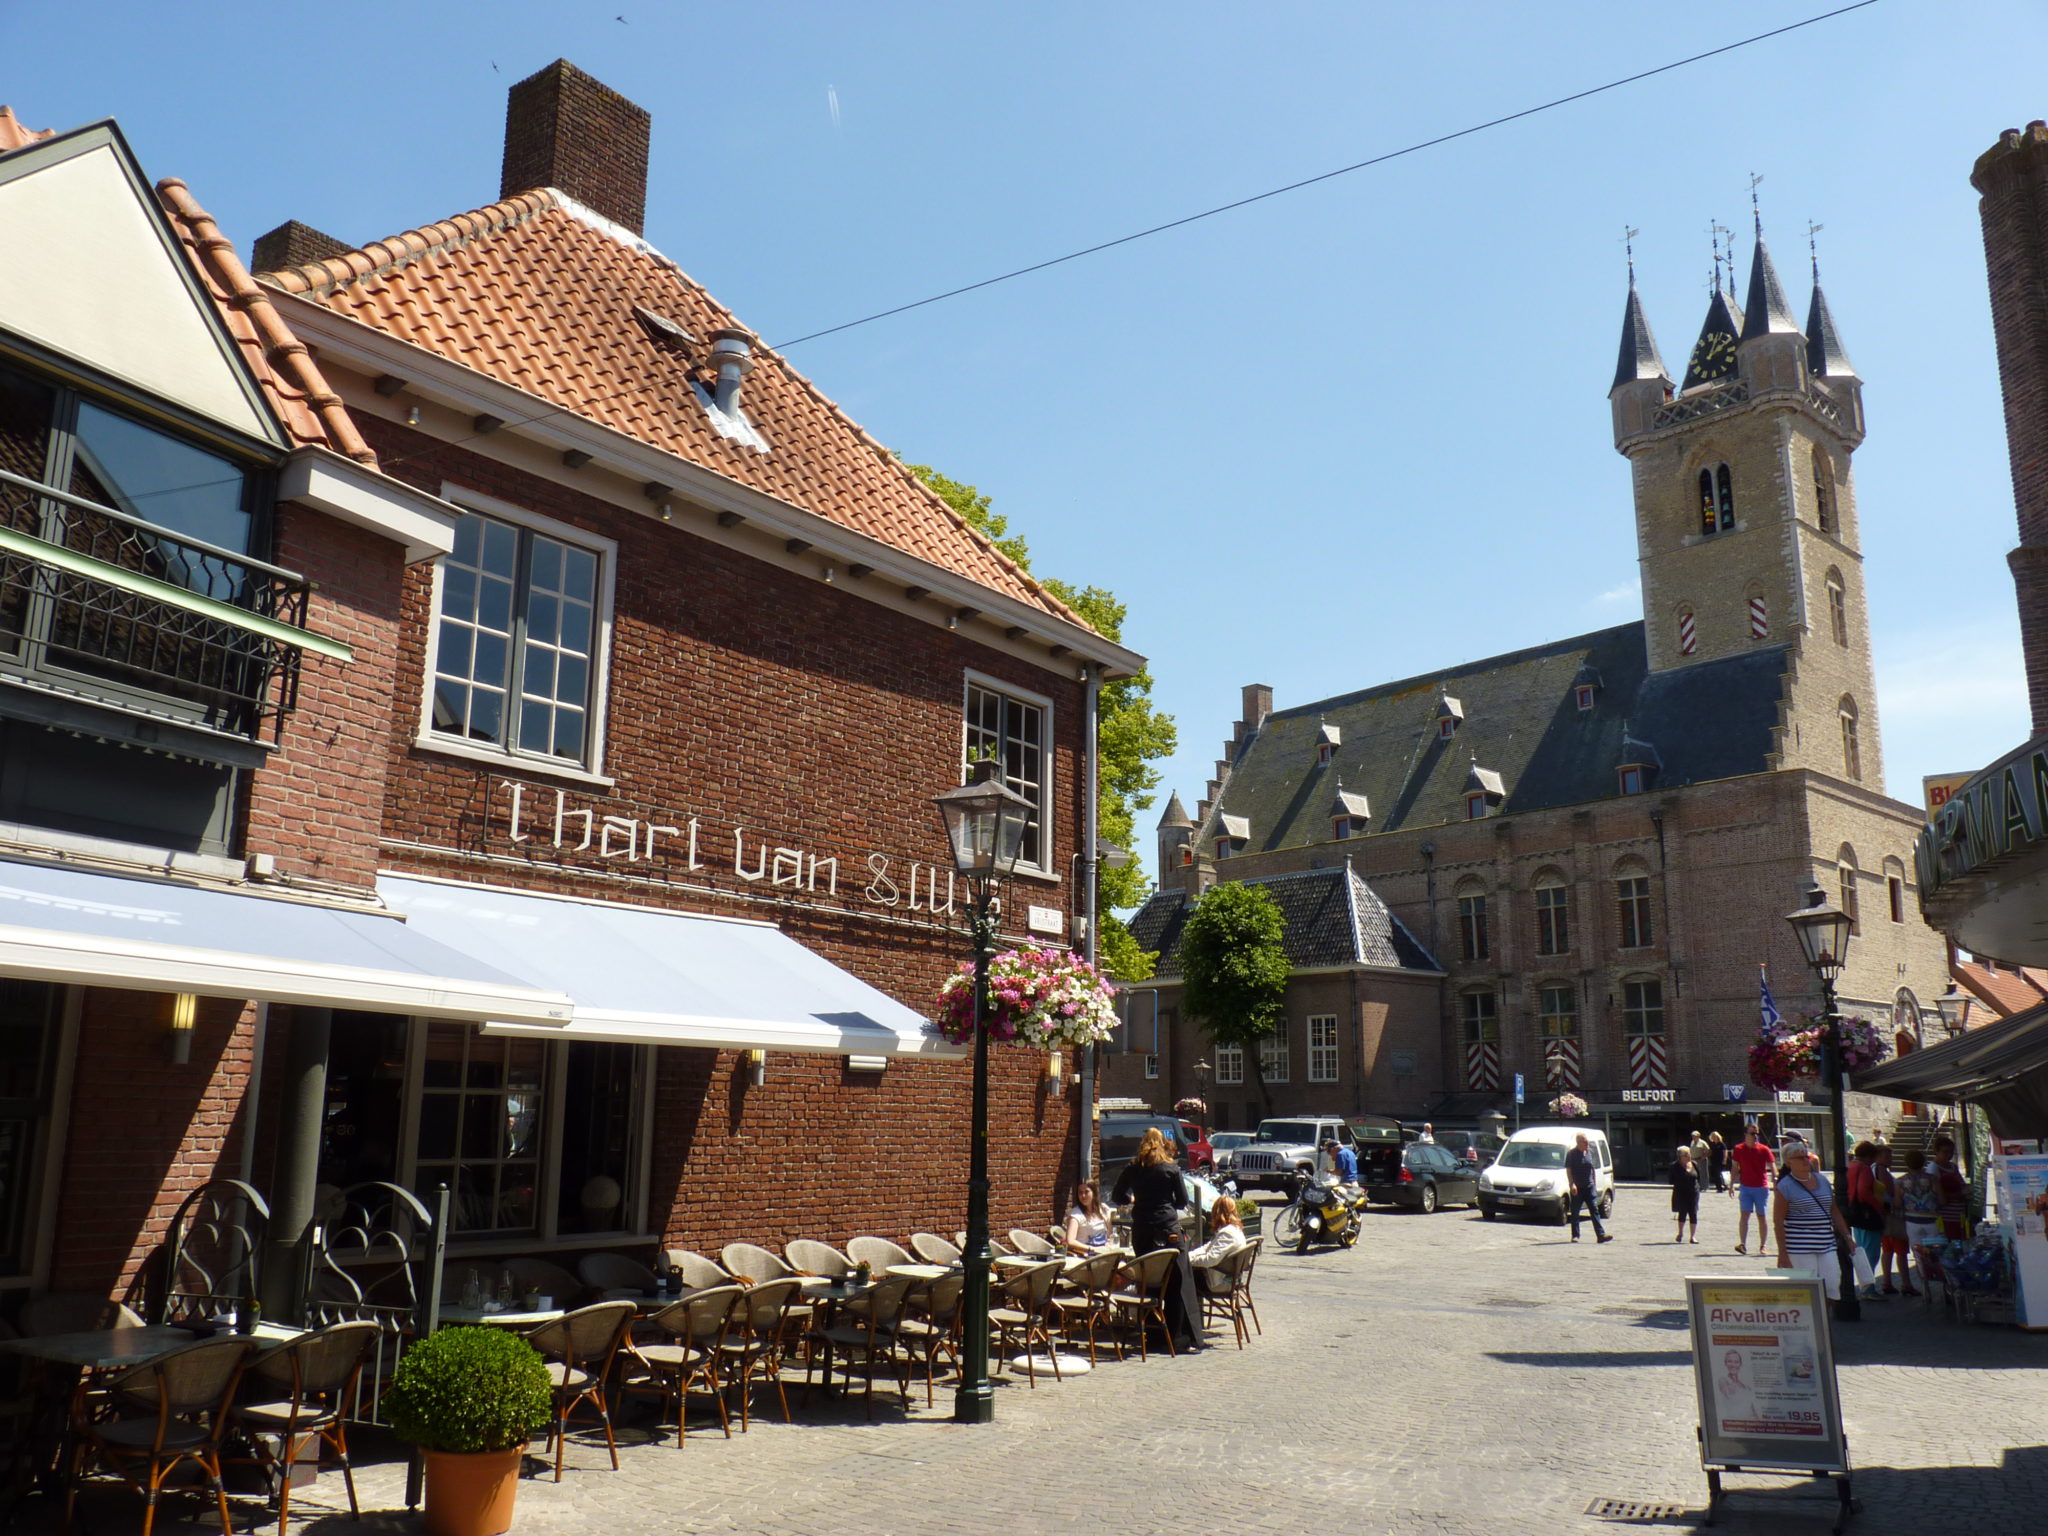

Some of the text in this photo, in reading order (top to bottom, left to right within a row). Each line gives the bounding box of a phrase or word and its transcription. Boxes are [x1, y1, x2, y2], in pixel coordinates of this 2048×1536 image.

[553, 789, 704, 872] hart
[734, 827, 837, 896] van
[1622, 1089, 1676, 1102] BELFORT
[1779, 1090, 1805, 1103] BELFORT
[1711, 1308, 1801, 1323] Afvallen?
